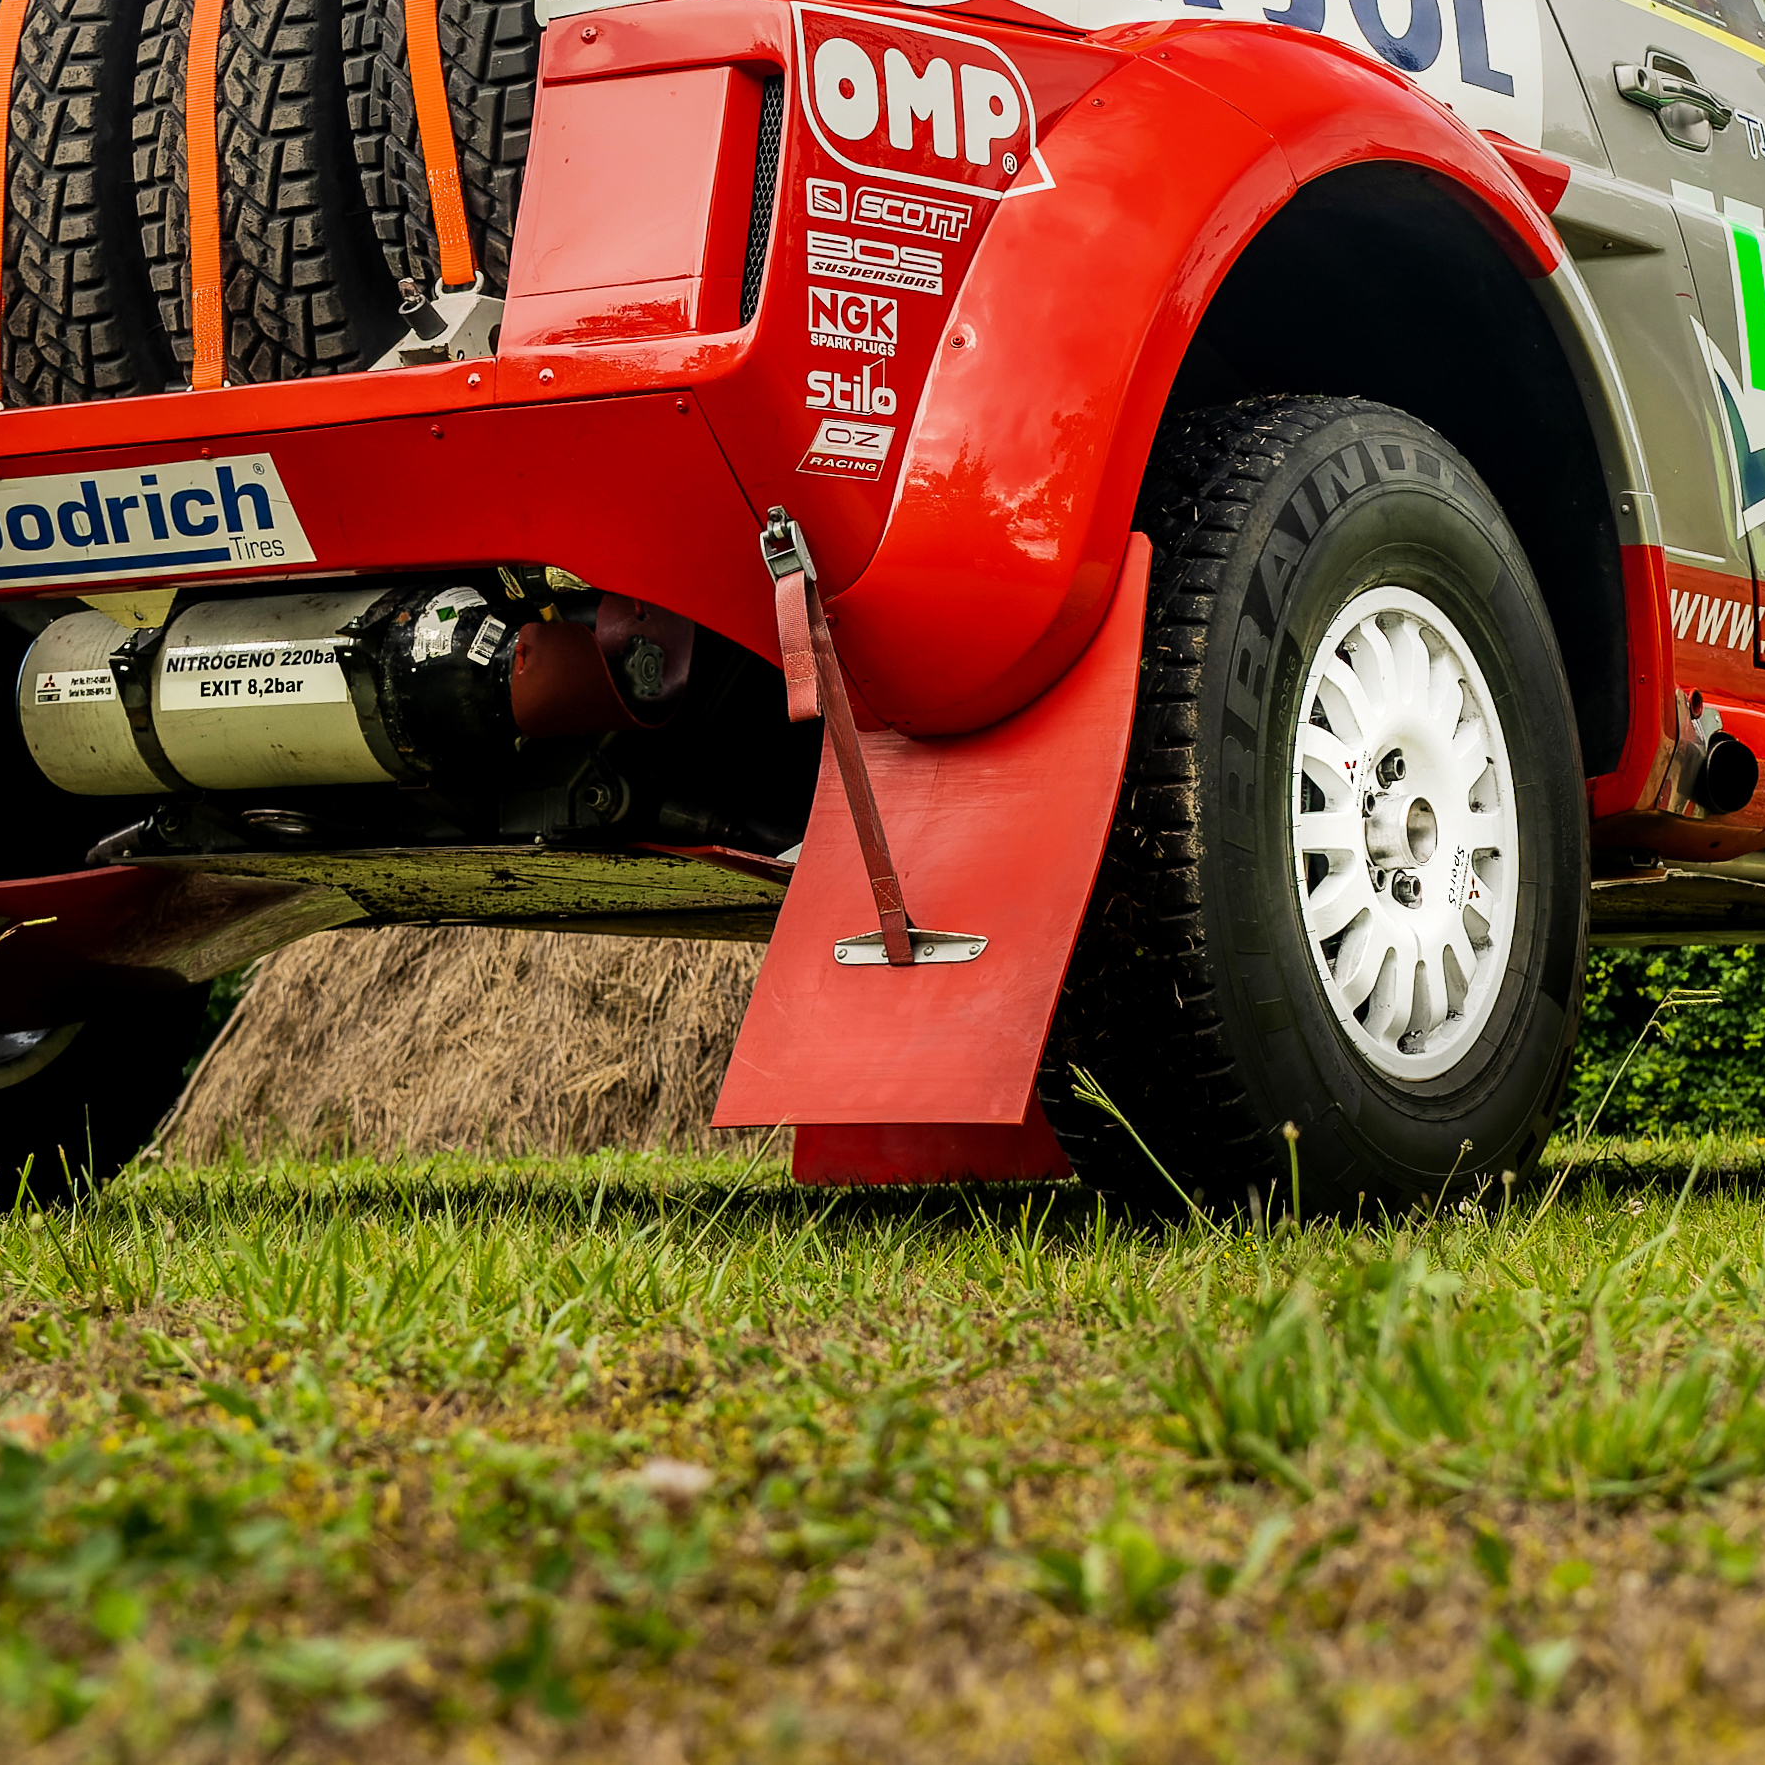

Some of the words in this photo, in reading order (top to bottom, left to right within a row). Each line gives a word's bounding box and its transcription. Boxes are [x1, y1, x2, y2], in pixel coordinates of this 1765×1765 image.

[813, 37, 1021, 167] OMP
[858, 194, 966, 233] SCOTT
[806, 229, 943, 275] BOS
[812, 261, 939, 290] suspensions
[811, 290, 896, 341] NGK
[810, 332, 853, 352] SPARK
[854, 339, 896, 358] PLUGS
[805, 364, 898, 416] Stilo
[809, 456, 878, 472] RACING
[229, 536, 285, 560] Tires
[280, 649, 340, 667] 220ba
[200, 679, 242, 697] EXIT
[247, 677, 304, 698] 8,2bar
